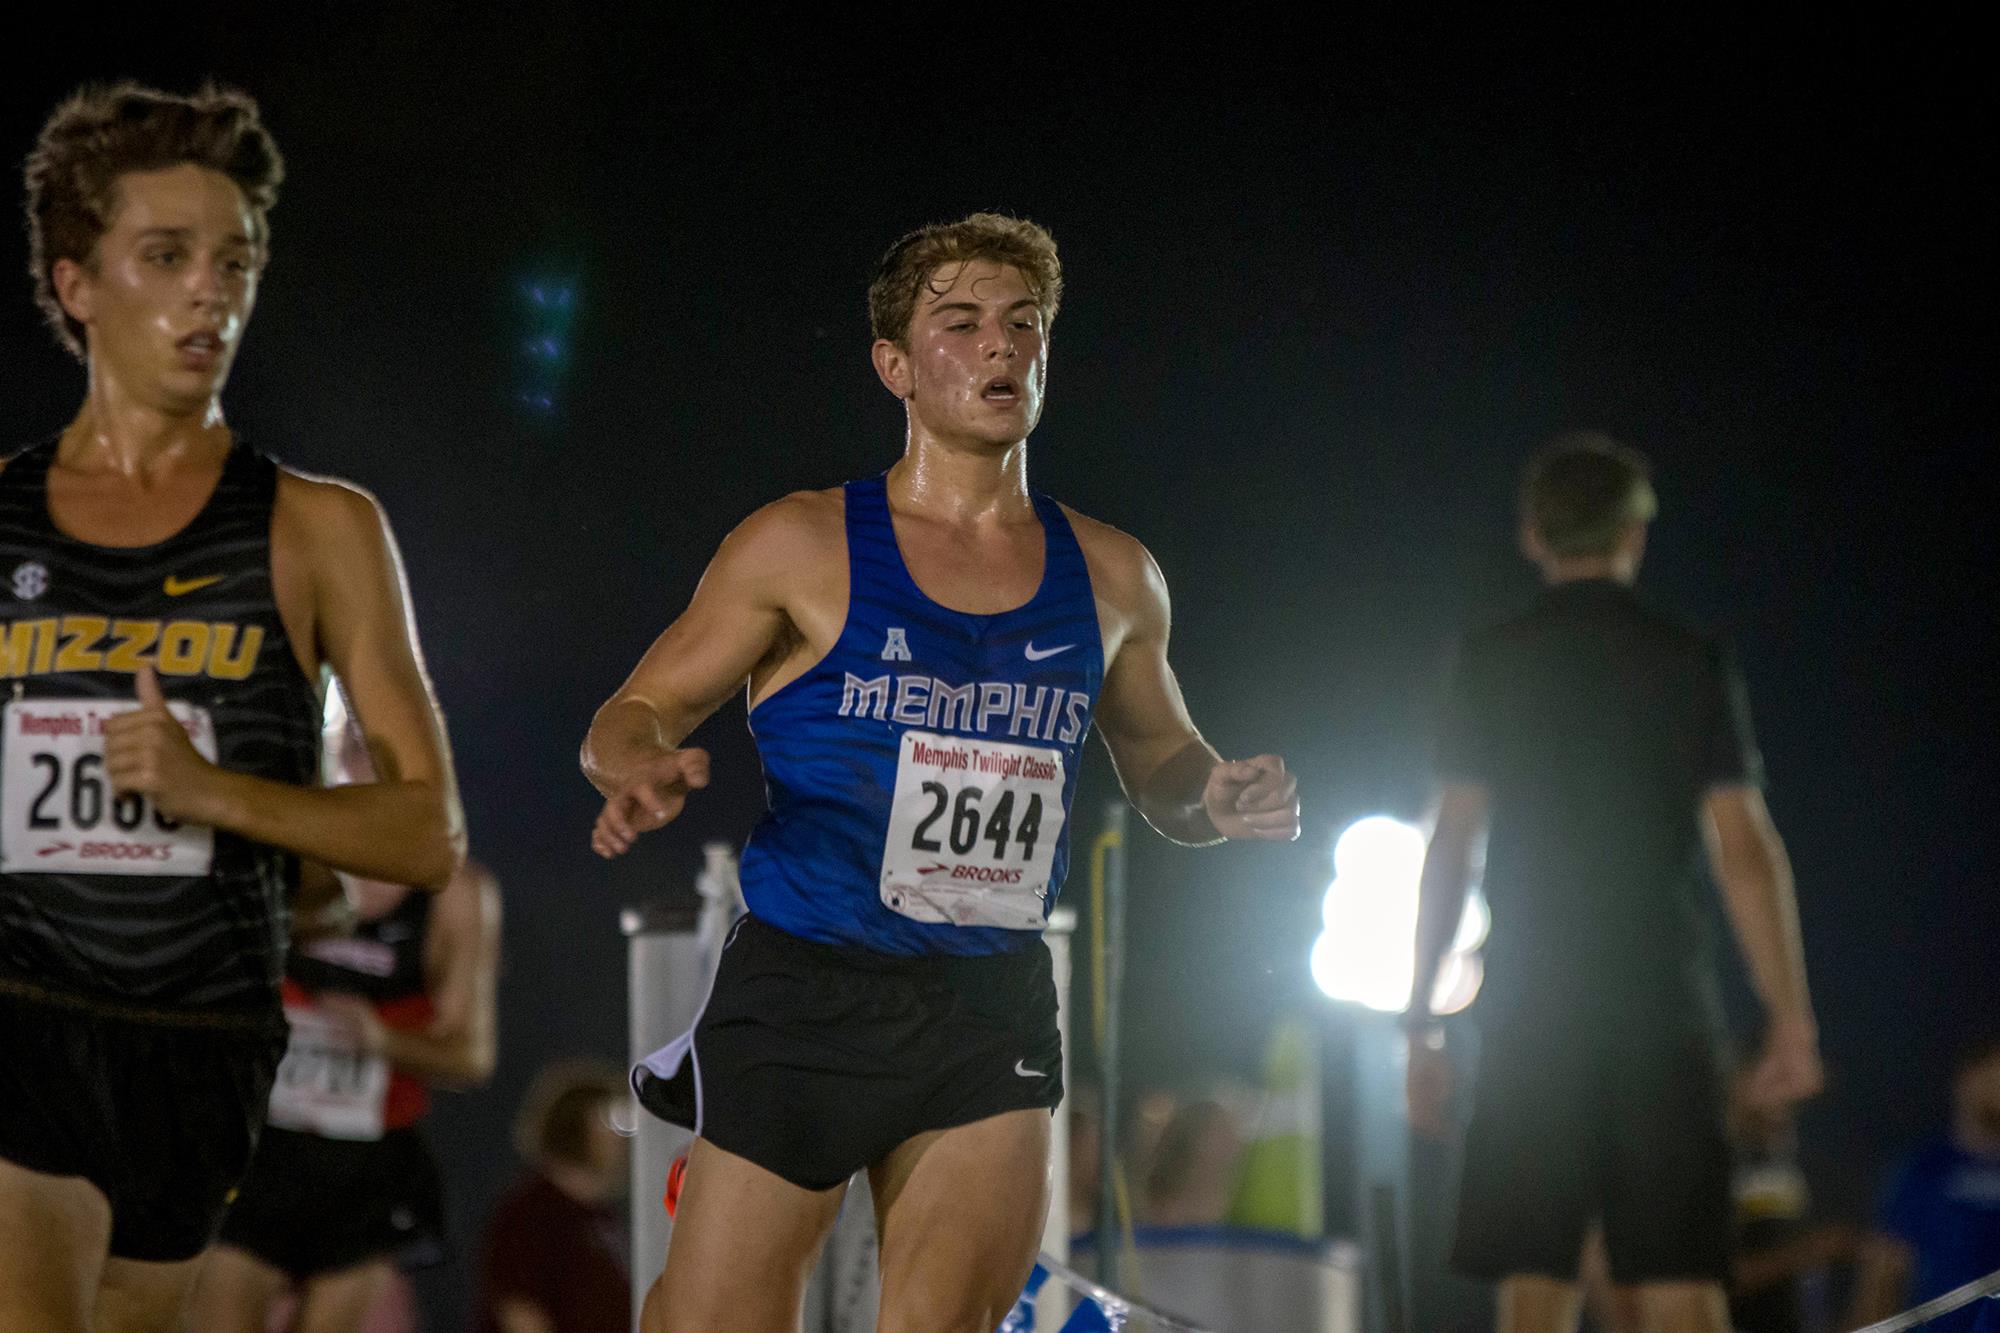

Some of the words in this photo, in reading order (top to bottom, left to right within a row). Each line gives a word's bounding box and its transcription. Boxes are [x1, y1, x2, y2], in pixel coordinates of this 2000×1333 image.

[881, 627, 912, 661] A
[838, 671, 1090, 744] MEMPHIS
[911, 741, 968, 772] Memphis
[972, 750, 1022, 780] Twilight
[1022, 755, 1057, 780] Classic
[911, 781, 1043, 861] 2644
[80, 842, 172, 860] BROOKS
[951, 864, 1023, 884] BROOKS
